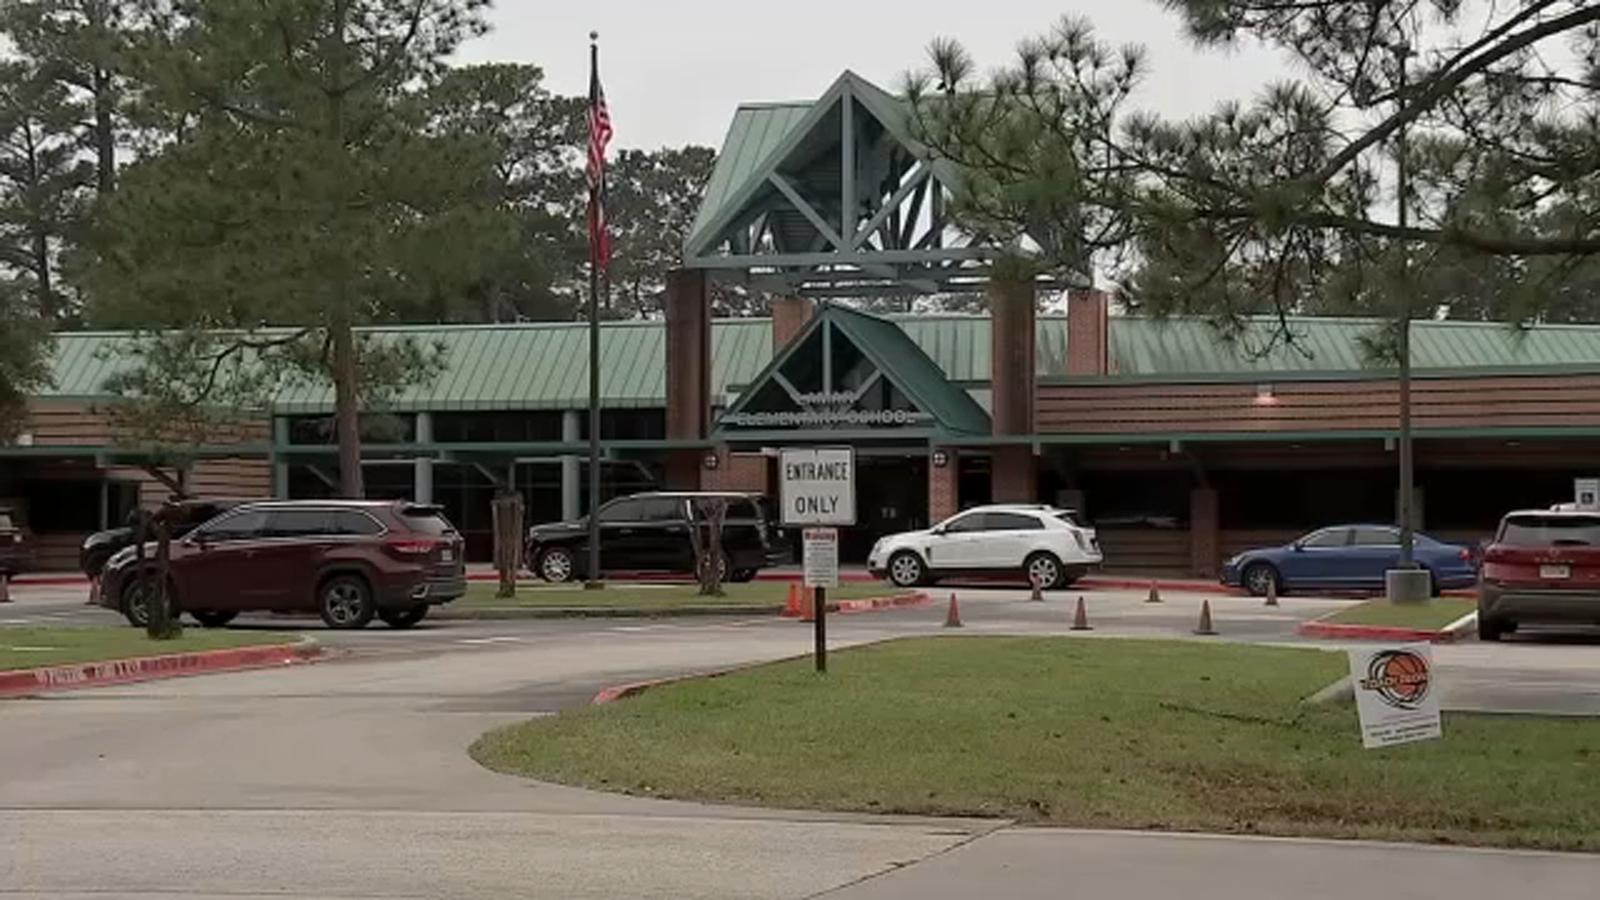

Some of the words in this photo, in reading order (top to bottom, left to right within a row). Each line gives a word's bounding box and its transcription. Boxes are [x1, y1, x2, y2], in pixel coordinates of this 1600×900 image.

[738, 412, 841, 427] ELEMENTARY
[848, 410, 916, 424] SCHOOL
[786, 462, 848, 481] ENTRANCE
[795, 496, 839, 514] ONLY
